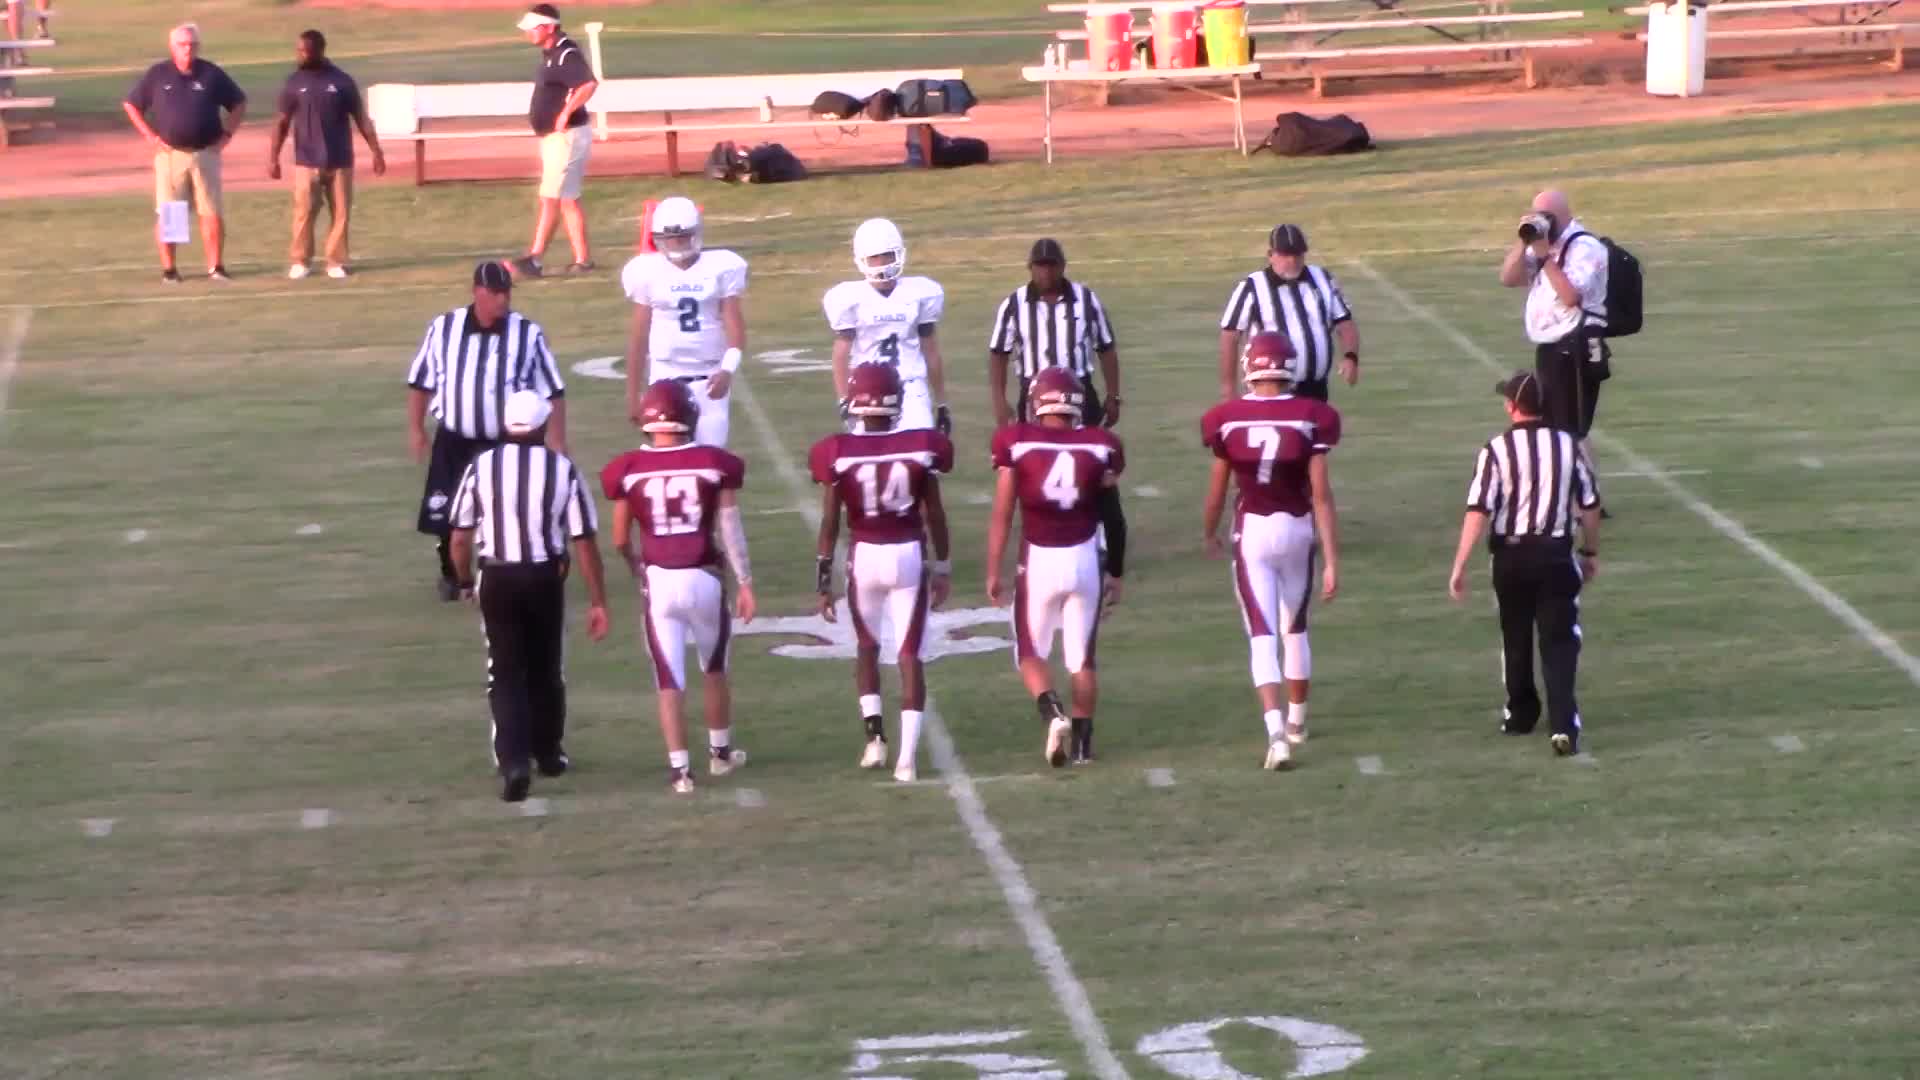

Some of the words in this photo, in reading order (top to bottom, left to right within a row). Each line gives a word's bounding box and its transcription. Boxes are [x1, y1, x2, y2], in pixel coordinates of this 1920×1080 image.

[678, 297, 701, 332] 2
[879, 333, 900, 367] 4
[1042, 451, 1079, 510] 4
[1247, 427, 1281, 484] 7
[643, 475, 703, 536] 13
[855, 461, 915, 517] 14
